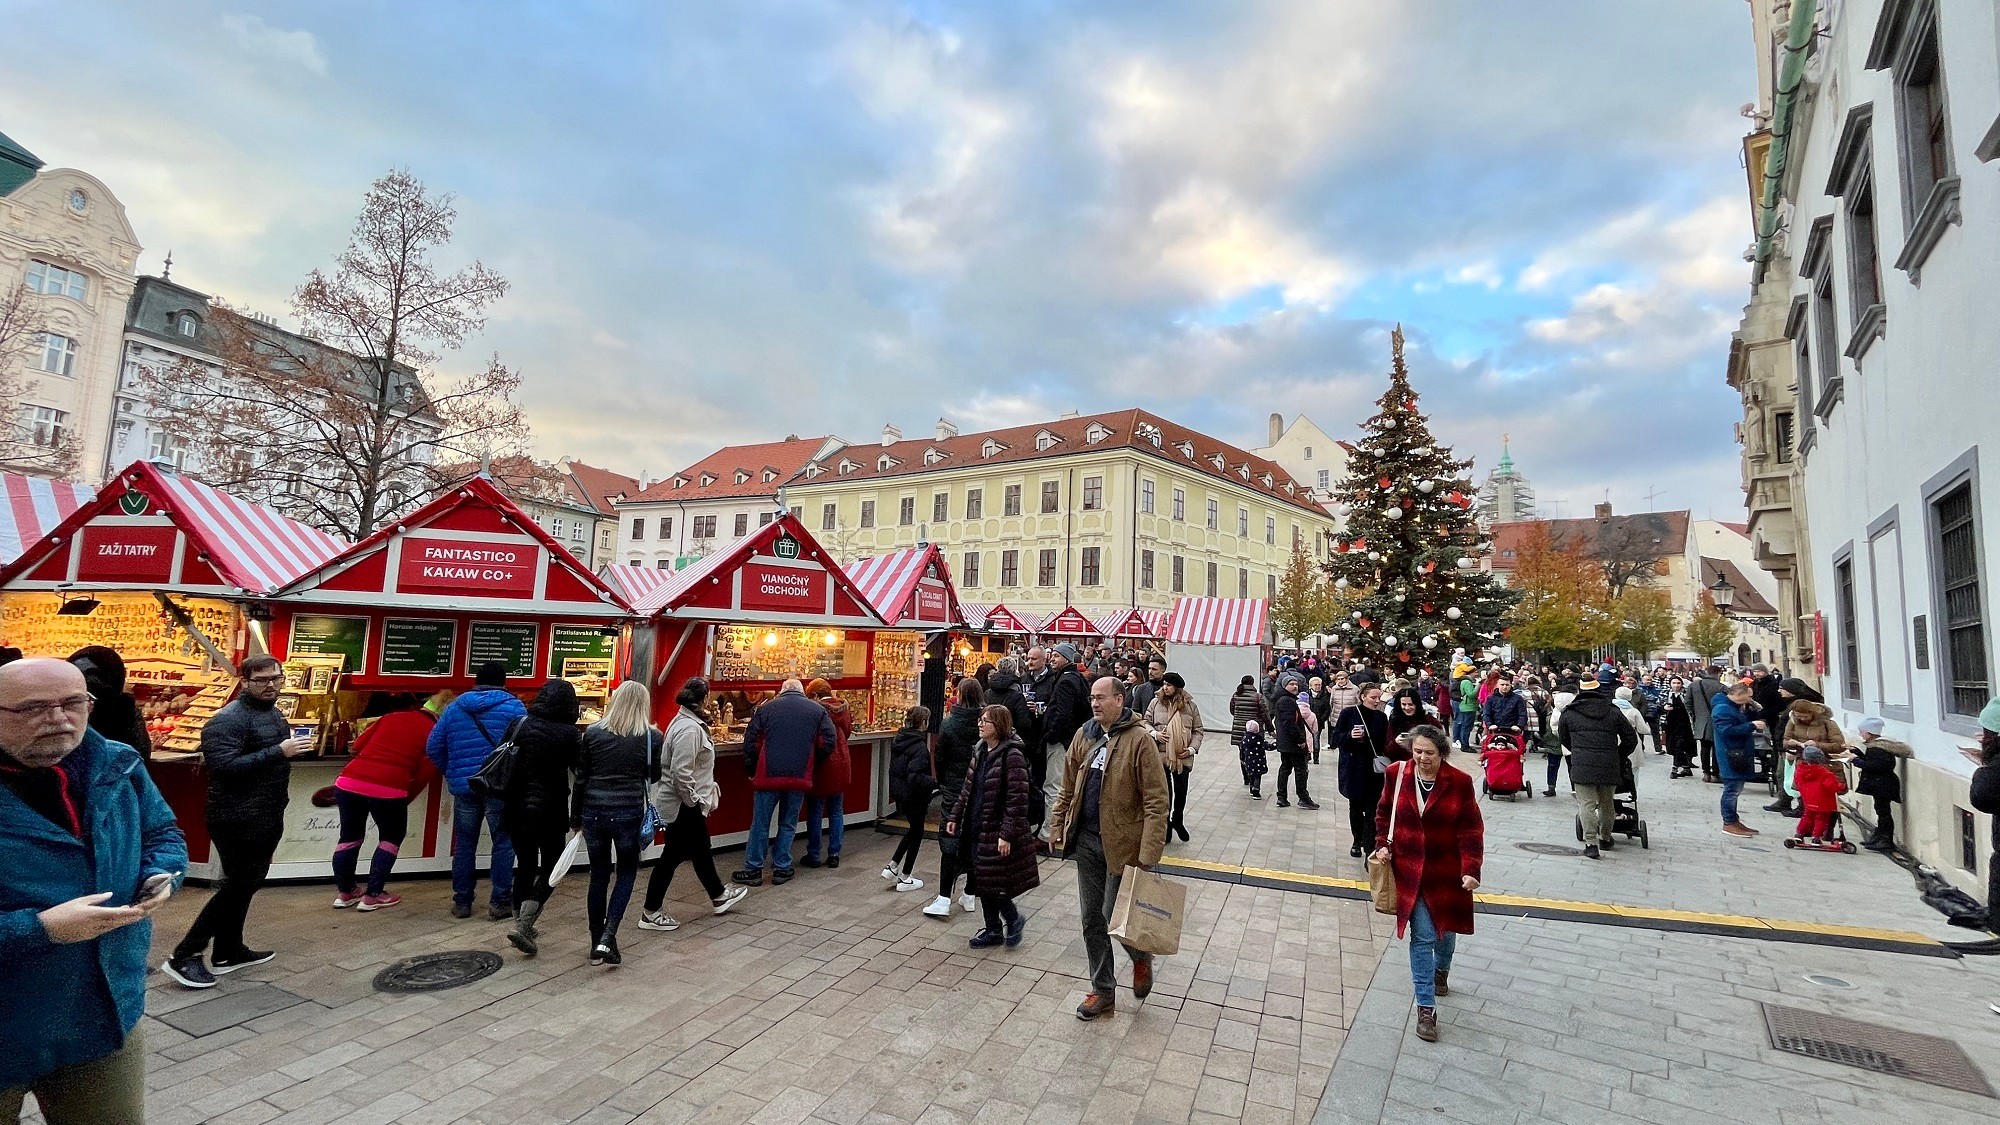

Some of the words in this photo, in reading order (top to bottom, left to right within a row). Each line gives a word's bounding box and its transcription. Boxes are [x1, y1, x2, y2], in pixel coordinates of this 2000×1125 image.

[98, 542, 122, 556] ZAŽI
[124, 545, 157, 556] TATRY
[425, 547, 516, 563] FANTASTICO
[423, 566, 479, 580] KAKAW
[482, 569, 513, 581] CO+
[761, 573, 809, 586] VIANOČNÝ
[761, 584, 809, 597] OBCHODÍK
